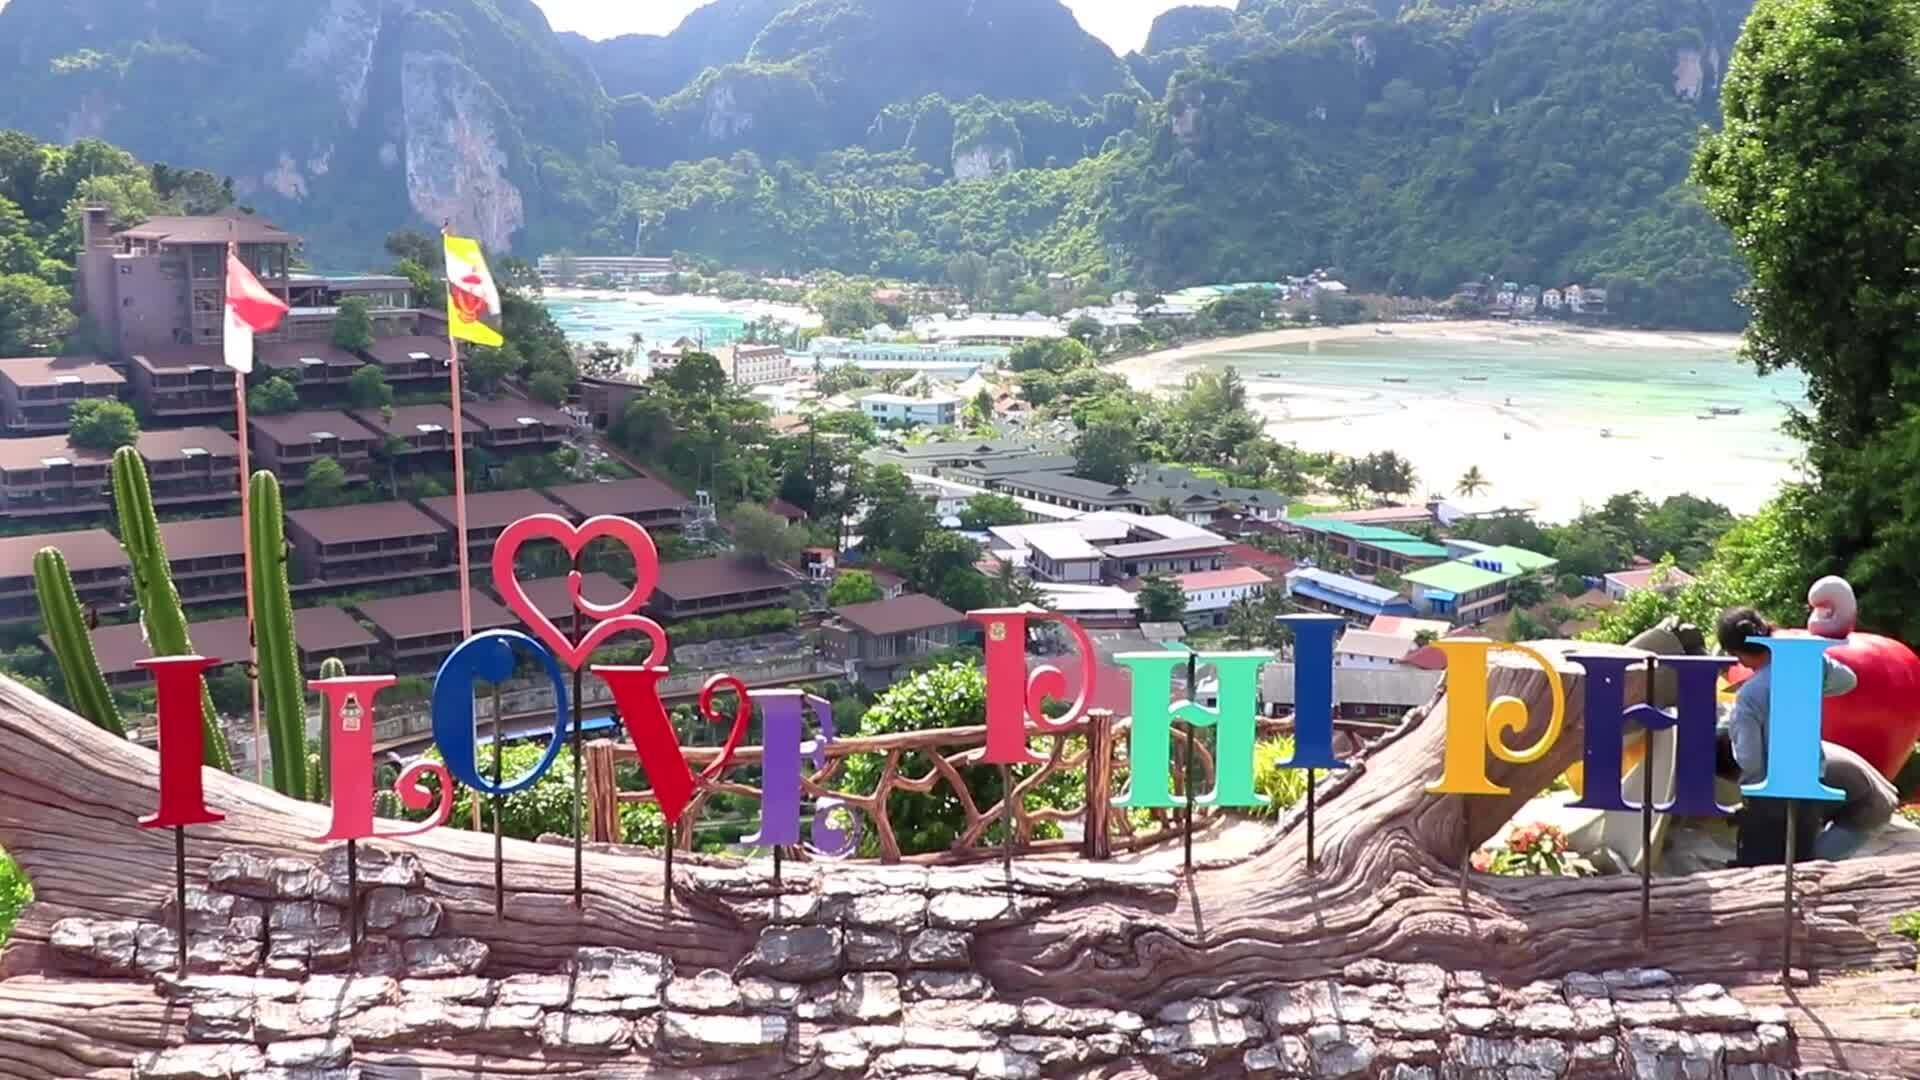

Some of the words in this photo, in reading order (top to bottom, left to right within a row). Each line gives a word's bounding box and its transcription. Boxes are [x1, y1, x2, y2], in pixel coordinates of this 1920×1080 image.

[134, 655, 226, 828] I
[307, 629, 863, 859] LOVE
[966, 607, 1351, 808] PHI
[1424, 635, 1846, 815] PHI
